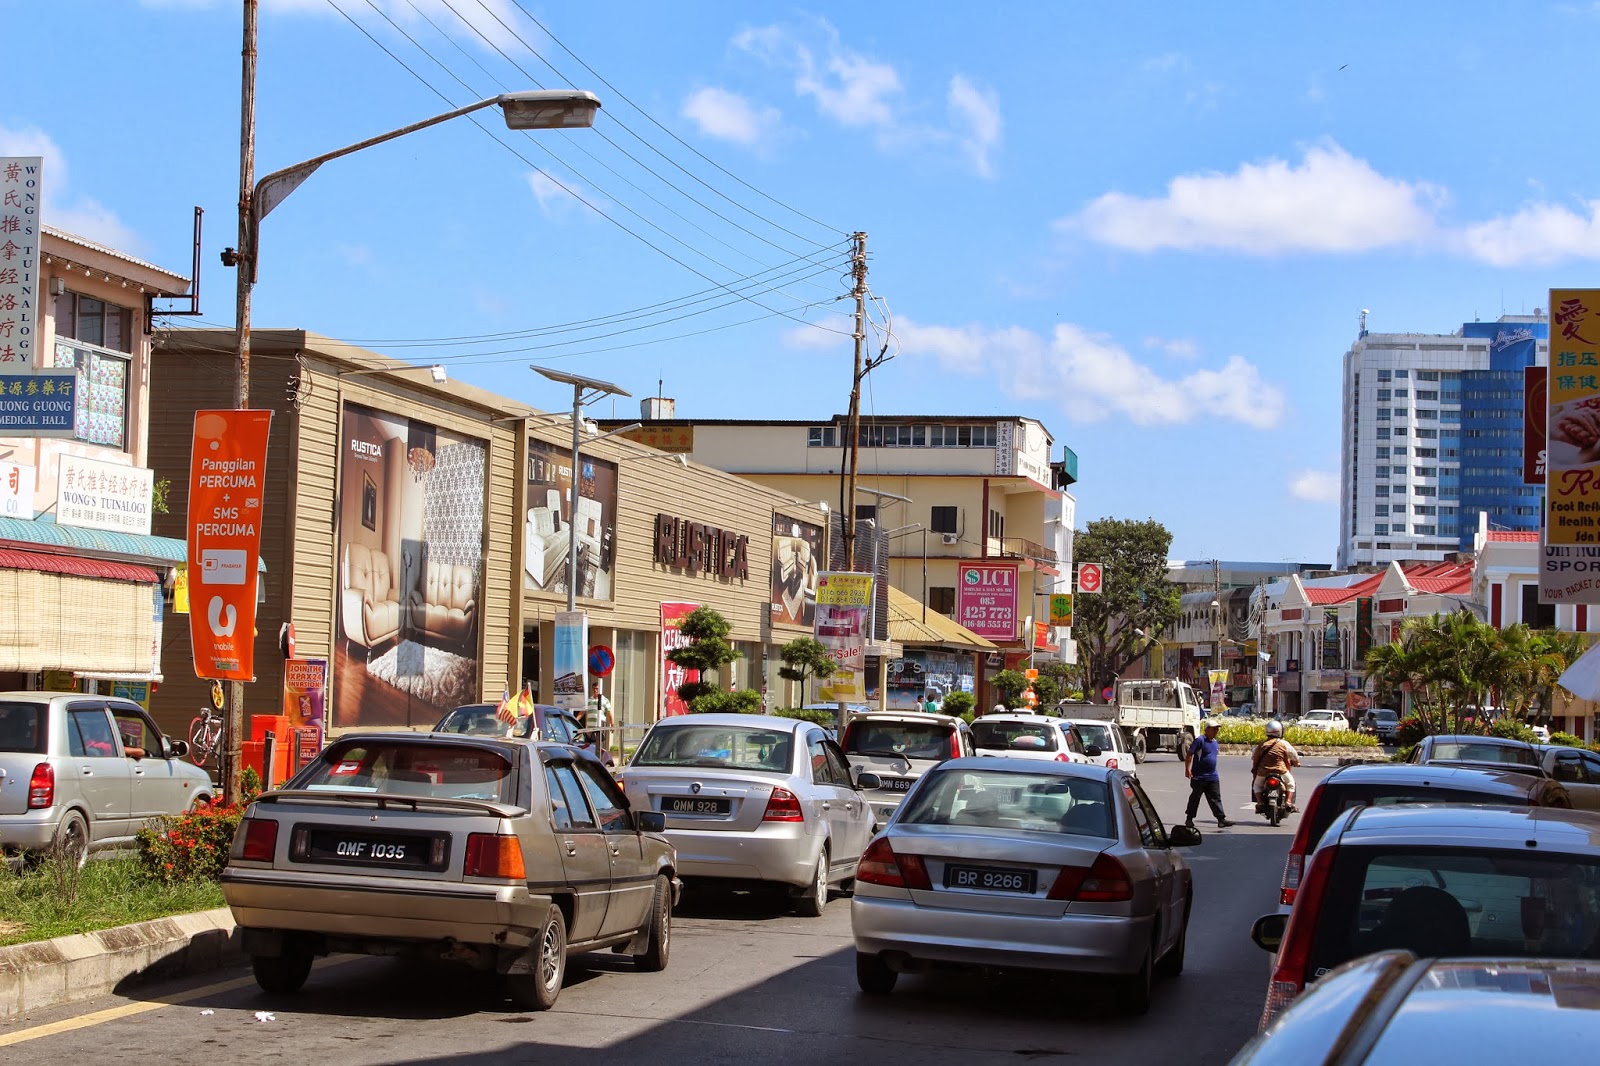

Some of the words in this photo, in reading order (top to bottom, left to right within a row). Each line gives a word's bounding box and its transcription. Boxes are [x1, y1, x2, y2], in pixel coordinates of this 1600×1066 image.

[20, 246, 34, 363] TUINALOGY
[1554, 298, 1600, 345] 愛
[33, 400, 72, 412] GUONG
[42, 415, 68, 425] HALL
[351, 439, 382, 457] RUSTICA
[1535, 449, 1546, 465] S
[201, 458, 256, 473] Panggilan
[199, 475, 257, 488] PERCUMA
[63, 491, 97, 507] WONG'S
[100, 497, 148, 514] TUINALOGY
[1551, 501, 1575, 512] Foot
[1577, 501, 1600, 512] Refl
[213, 506, 239, 520] SMS
[1558, 516, 1594, 527] Health
[196, 523, 256, 537] PERCUMA
[1575, 530, 1594, 542] Sdn
[653, 512, 750, 581] RUSTICA
[982, 569, 1012, 586] LCT
[821, 588, 834, 596] 016
[1544, 587, 1563, 599] YOUR
[1566, 579, 1593, 597] RACKET
[979, 597, 995, 606] 085
[963, 606, 987, 619] 425
[989, 607, 1012, 620] 773
[987, 620, 1001, 629] 555
[1002, 620, 1012, 629] 87
[213, 642, 235, 652] mobile
[836, 645, 862, 660] Sale!
[290, 664, 306, 673] JOIN
[309, 665, 323, 673] THE
[288, 681, 323, 689] INVASION!
[894, 780, 914, 790] 669
[673, 799, 694, 812] QMM
[697, 800, 718, 813] 928
[336, 841, 368, 857] QMF
[370, 843, 406, 859] 1035
[957, 870, 978, 885] BR
[983, 873, 1022, 888] 9266
